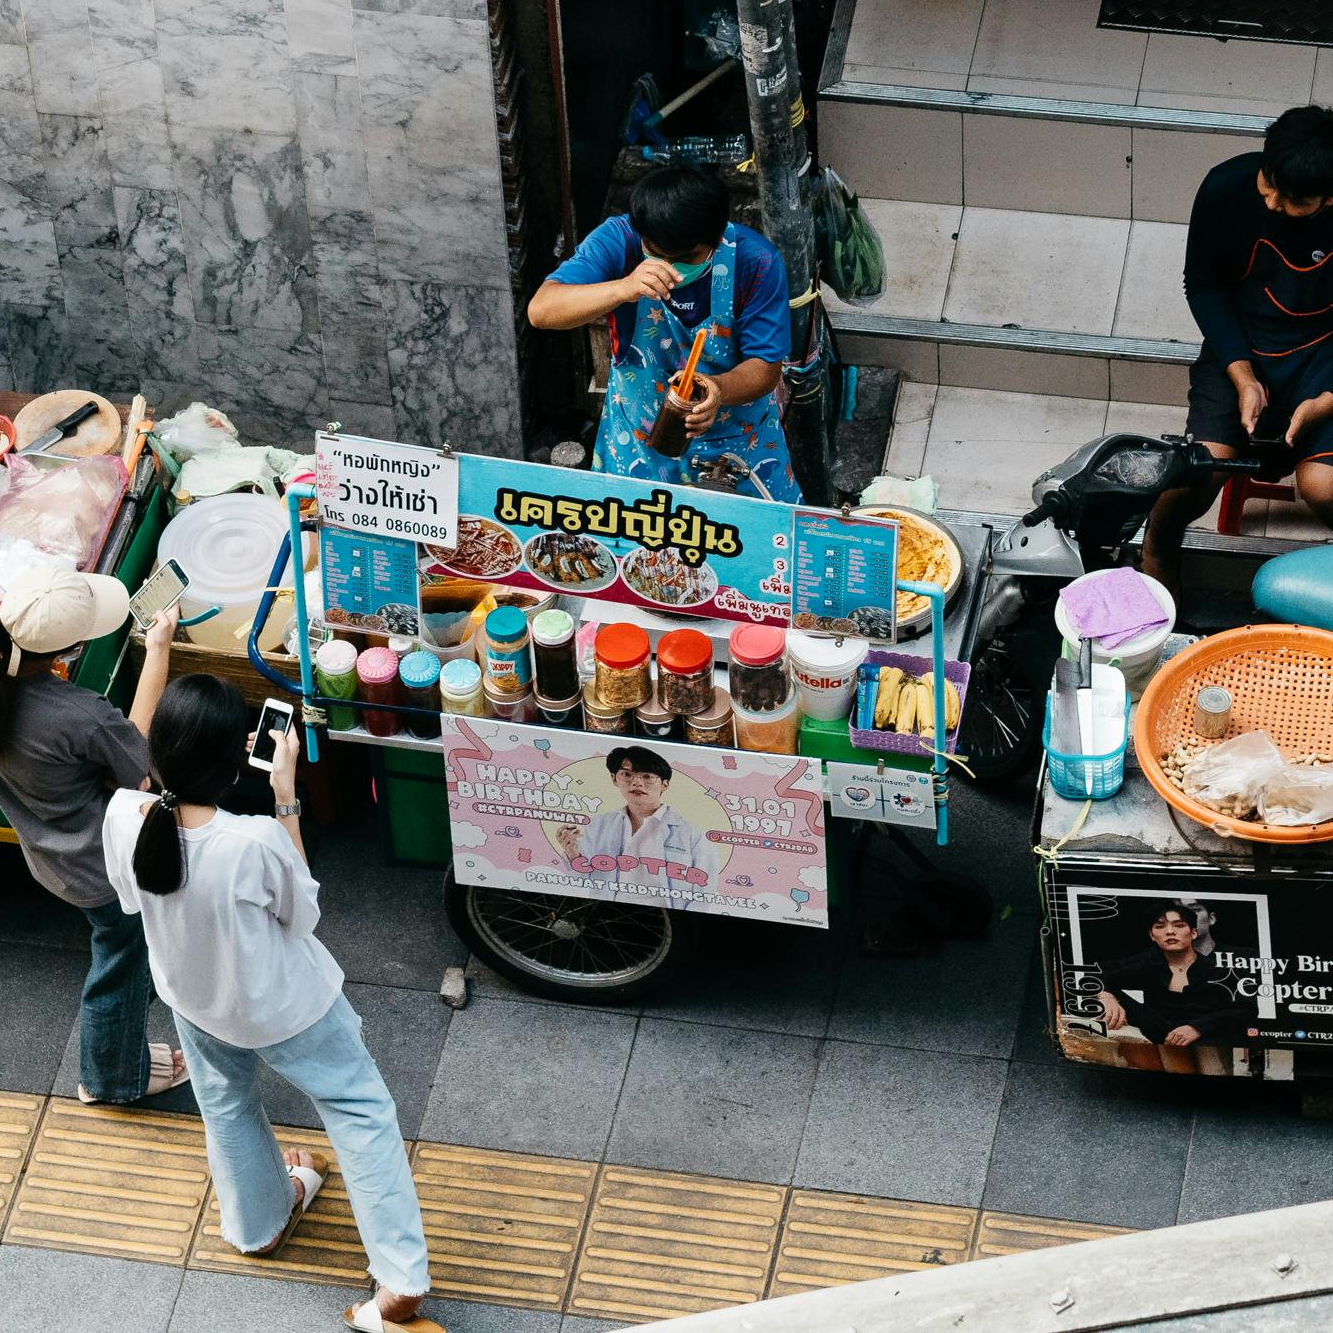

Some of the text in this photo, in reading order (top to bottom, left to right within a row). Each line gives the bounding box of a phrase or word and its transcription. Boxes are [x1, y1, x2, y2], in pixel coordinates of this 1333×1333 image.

[339, 479, 438, 515] ว่างให้เช่า
[324, 504, 447, 540] โทร 084 0860089
[499, 493, 738, 563] เครปญี่ปุ่น
[775, 536, 785, 546] 2
[776, 560, 785, 570] 3
[476, 763, 573, 791] HAPPY
[457, 780, 603, 813] BIRTHDAY
[724, 794, 795, 818] 31.01
[478, 803, 586, 825] #CTRPANUWAT
[730, 814, 792, 837] 1997
[721, 836, 760, 846] CCOPTER
[570, 855, 709, 887] COPTER
[526, 871, 757, 909] PANUWAT KERDTHONGTAVEE
[1215, 952, 1289, 975] Happy
[1061, 962, 1108, 1038] 1997
[1237, 977, 1332, 1003] Copter
[1260, 1031, 1293, 1039] ccopter
